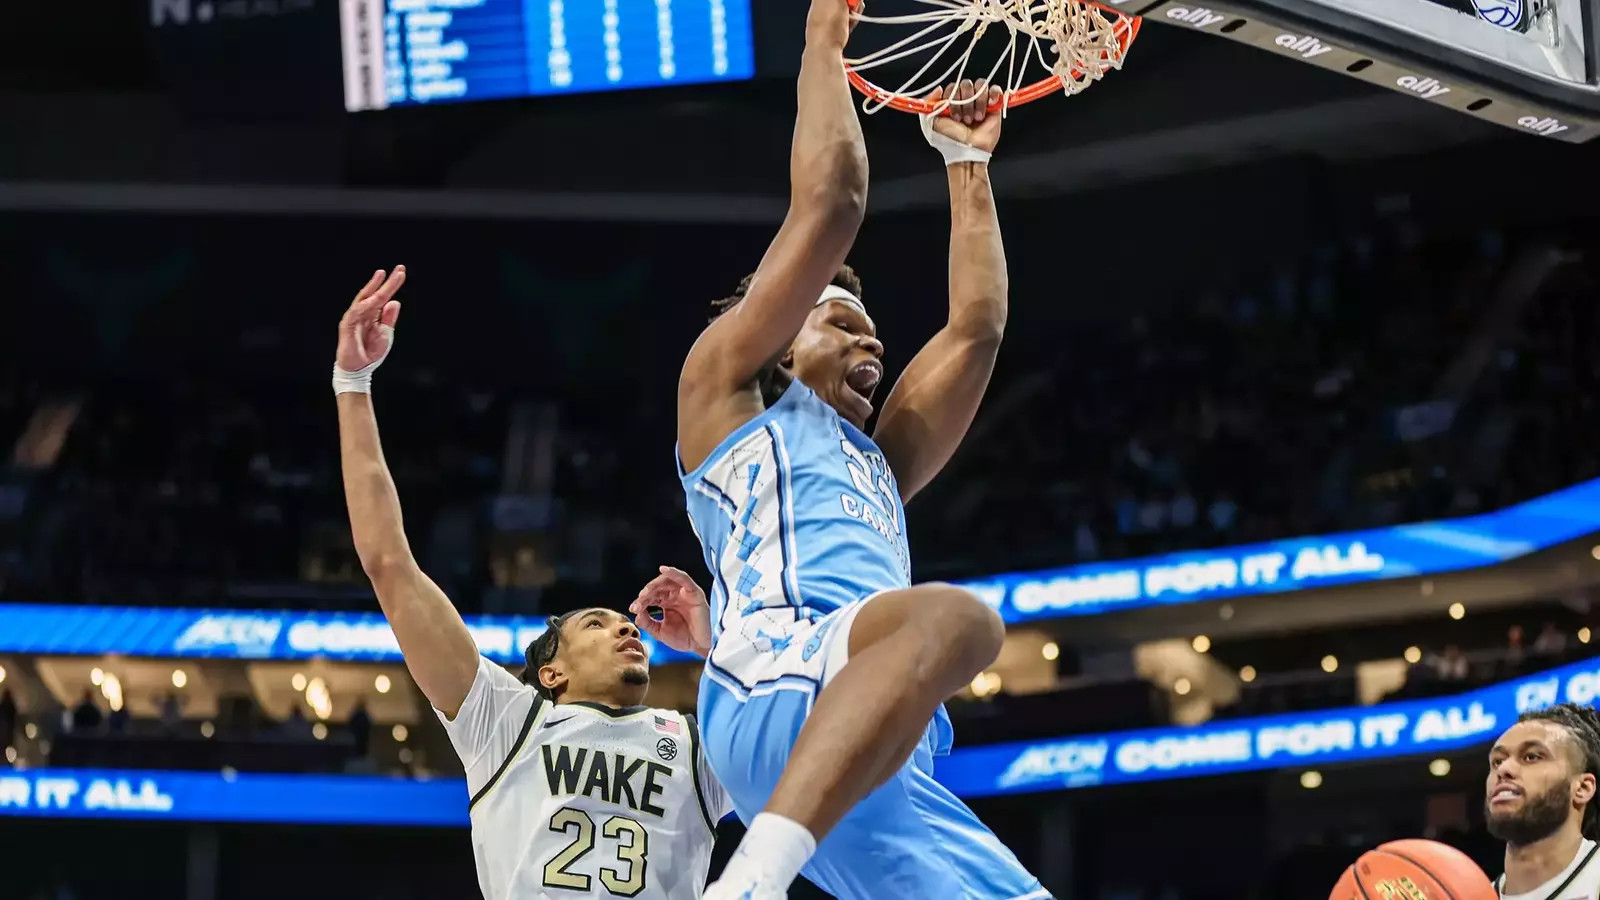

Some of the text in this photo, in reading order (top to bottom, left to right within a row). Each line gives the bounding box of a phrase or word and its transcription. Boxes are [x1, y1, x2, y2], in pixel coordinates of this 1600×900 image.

[1166, 7, 1224, 28] ally
[1275, 34, 1332, 58] ally
[1396, 75, 1451, 99] ally
[1517, 115, 1569, 136] ally
[1012, 569, 1140, 613] COME
[1144, 558, 1238, 598] FOR
[1241, 552, 1287, 586] IT
[1291, 541, 1385, 580] ALL
[1115, 729, 1251, 774] COME
[1256, 718, 1355, 760] FOR
[1359, 712, 1409, 748] IT
[1412, 700, 1497, 744] ALL
[35, 777, 79, 809] IT
[83, 778, 174, 812] ALL
[541, 744, 673, 818] WAKE
[542, 806, 649, 898] 23
